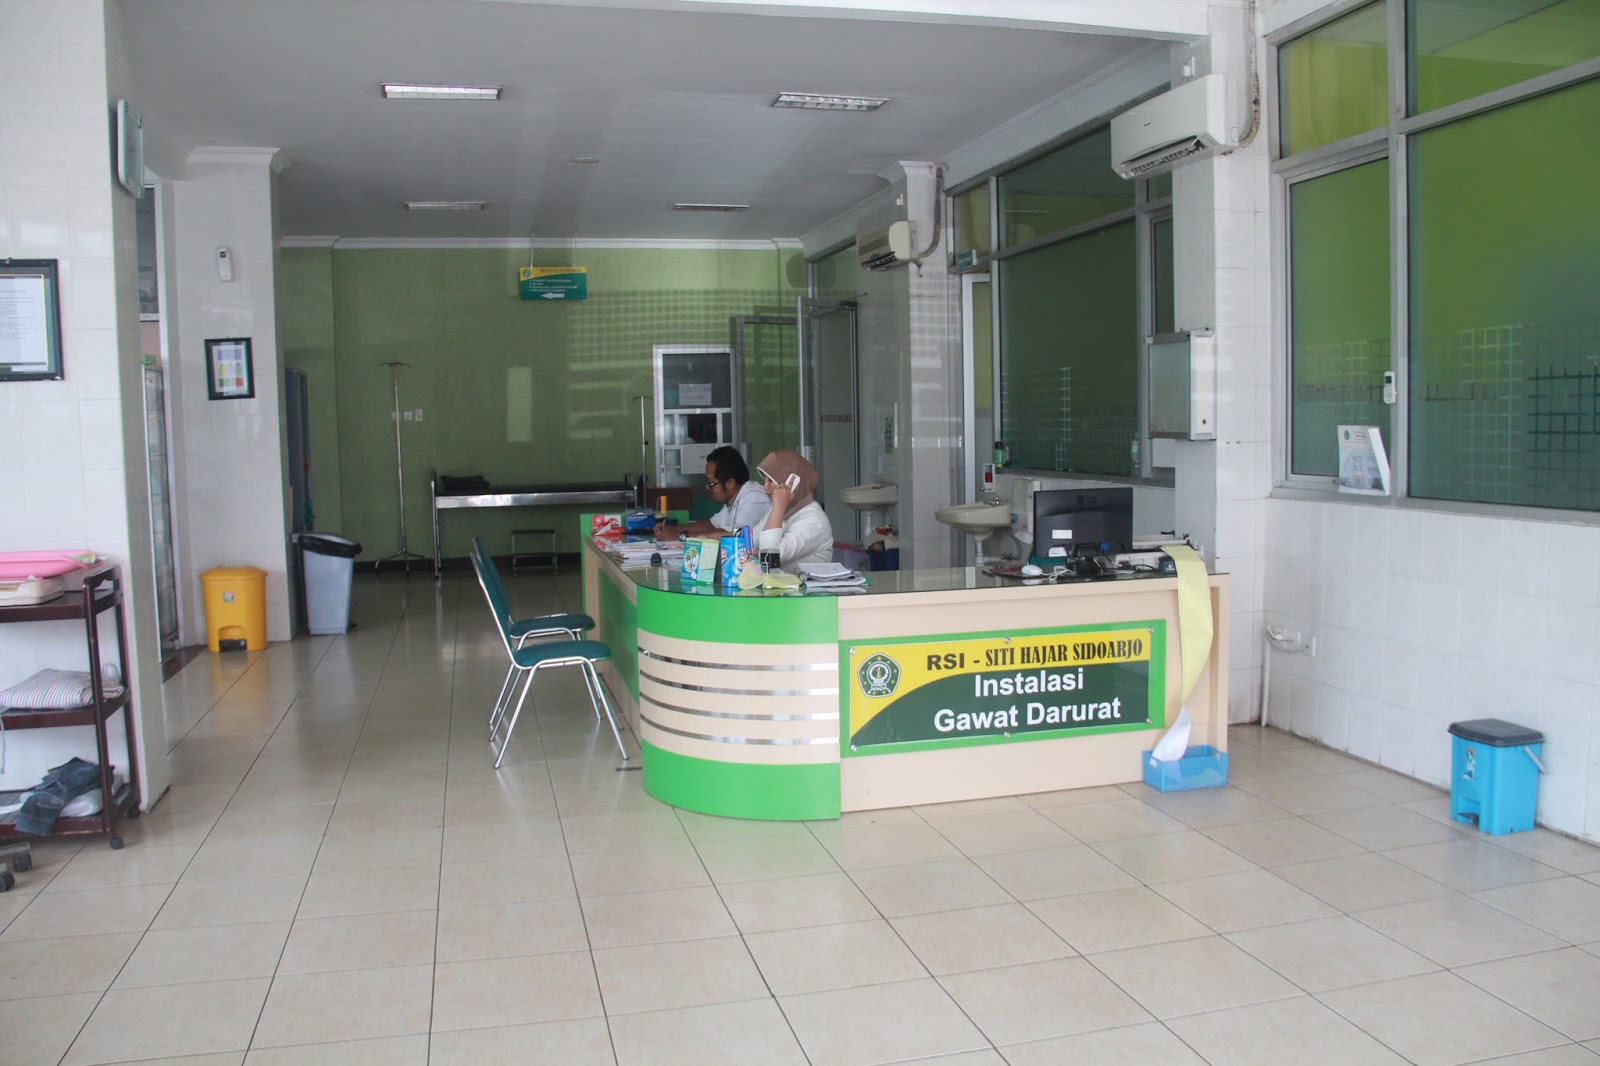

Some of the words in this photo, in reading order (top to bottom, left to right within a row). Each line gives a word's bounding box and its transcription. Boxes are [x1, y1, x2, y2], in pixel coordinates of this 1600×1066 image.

[926, 653, 965, 671] RSI
[985, 648, 1015, 667] SITI
[1020, 644, 1068, 664] HAJAR
[1072, 638, 1143, 660] SIDOARJO
[974, 667, 1084, 697] Instalasi
[933, 705, 1019, 732] Gawat
[1027, 697, 1121, 724] Darurat
